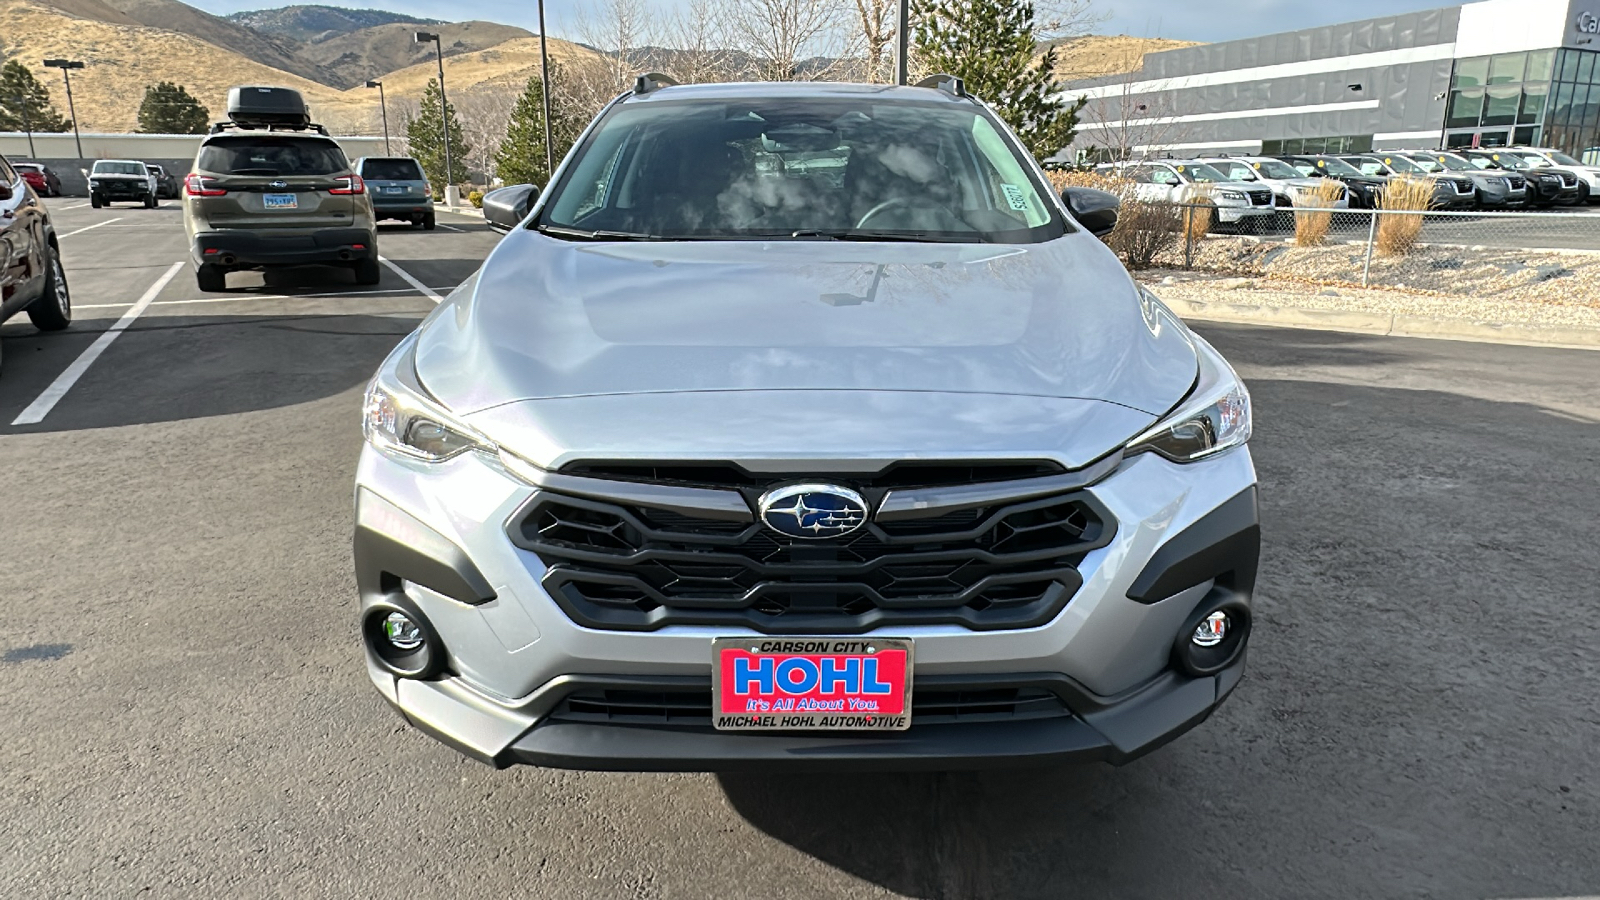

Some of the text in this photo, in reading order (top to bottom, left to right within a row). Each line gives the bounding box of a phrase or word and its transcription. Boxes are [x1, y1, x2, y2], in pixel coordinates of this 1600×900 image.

[760, 641, 870, 653] CARSON CITY
[734, 657, 892, 695] HOHL
[746, 698, 880, 711] It's All About You.
[718, 716, 906, 728] MICHAEL HOHL AUTOMOTIVE
